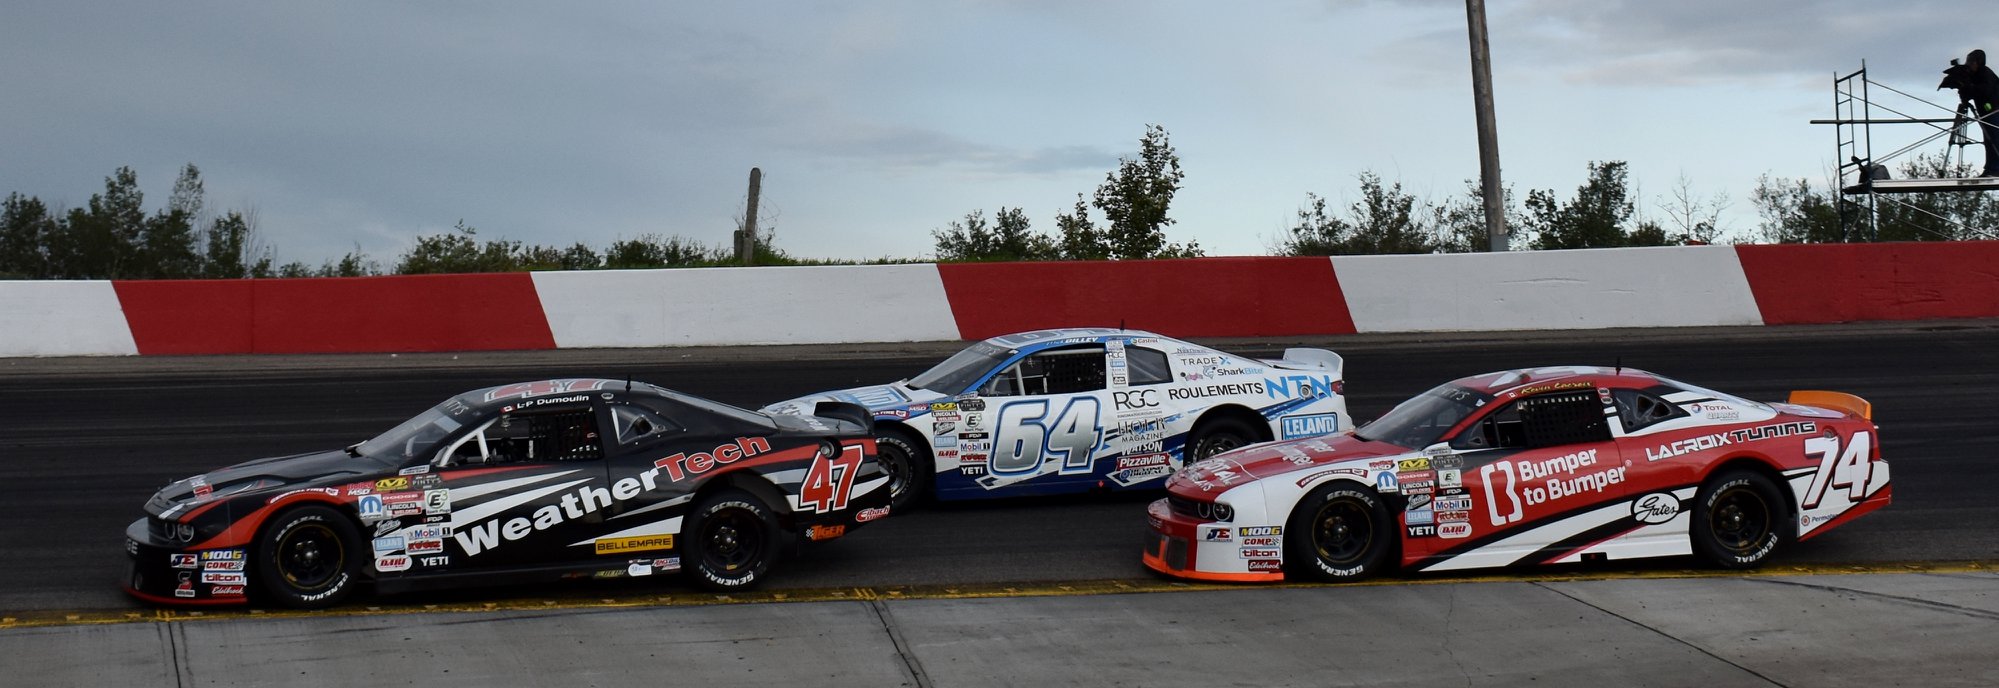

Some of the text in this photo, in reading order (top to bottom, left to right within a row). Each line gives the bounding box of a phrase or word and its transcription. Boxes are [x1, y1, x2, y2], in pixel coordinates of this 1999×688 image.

[1217, 367, 1263, 376] SharkBite
[1168, 382, 1264, 400] ROULEMENTS
[1263, 374, 1333, 400] NTN
[536, 395, 590, 406] Dumoulin
[1112, 389, 1160, 411] RGC
[1285, 416, 1336, 436] LELAND
[990, 396, 1104, 477] 64
[1121, 433, 1165, 443] MAGAZINE
[960, 443, 981, 451] Mobil
[1121, 440, 1163, 456] WATSON
[1119, 454, 1166, 468] Pizzaville
[1517, 448, 1597, 482] Bumper
[961, 466, 983, 475] YETI
[1801, 430, 1874, 511] 74
[800, 444, 864, 514] 47
[453, 436, 771, 557] WeatherTech
[1327, 490, 1374, 509] GENERAL
[1523, 486, 1546, 506] to
[709, 501, 761, 516] GENERAL
[1436, 500, 1460, 509] Mobil
[1635, 496, 1678, 521] Gates
[415, 529, 440, 538] Mobil
[811, 525, 846, 540] TIGER
[1241, 527, 1281, 536] MOOG
[1408, 525, 1434, 536] YETI
[597, 539, 672, 551] BELLEMARE
[1735, 532, 1778, 563] GENERAL
[201, 550, 243, 561] MOOG
[1242, 549, 1278, 557] tilton
[206, 561, 234, 570] COMP
[420, 556, 449, 567] YETI
[1316, 556, 1364, 577] GENERAL
[205, 573, 241, 582] tilton
[706, 570, 754, 586] GENERAL
[301, 573, 348, 601] GENERAL
